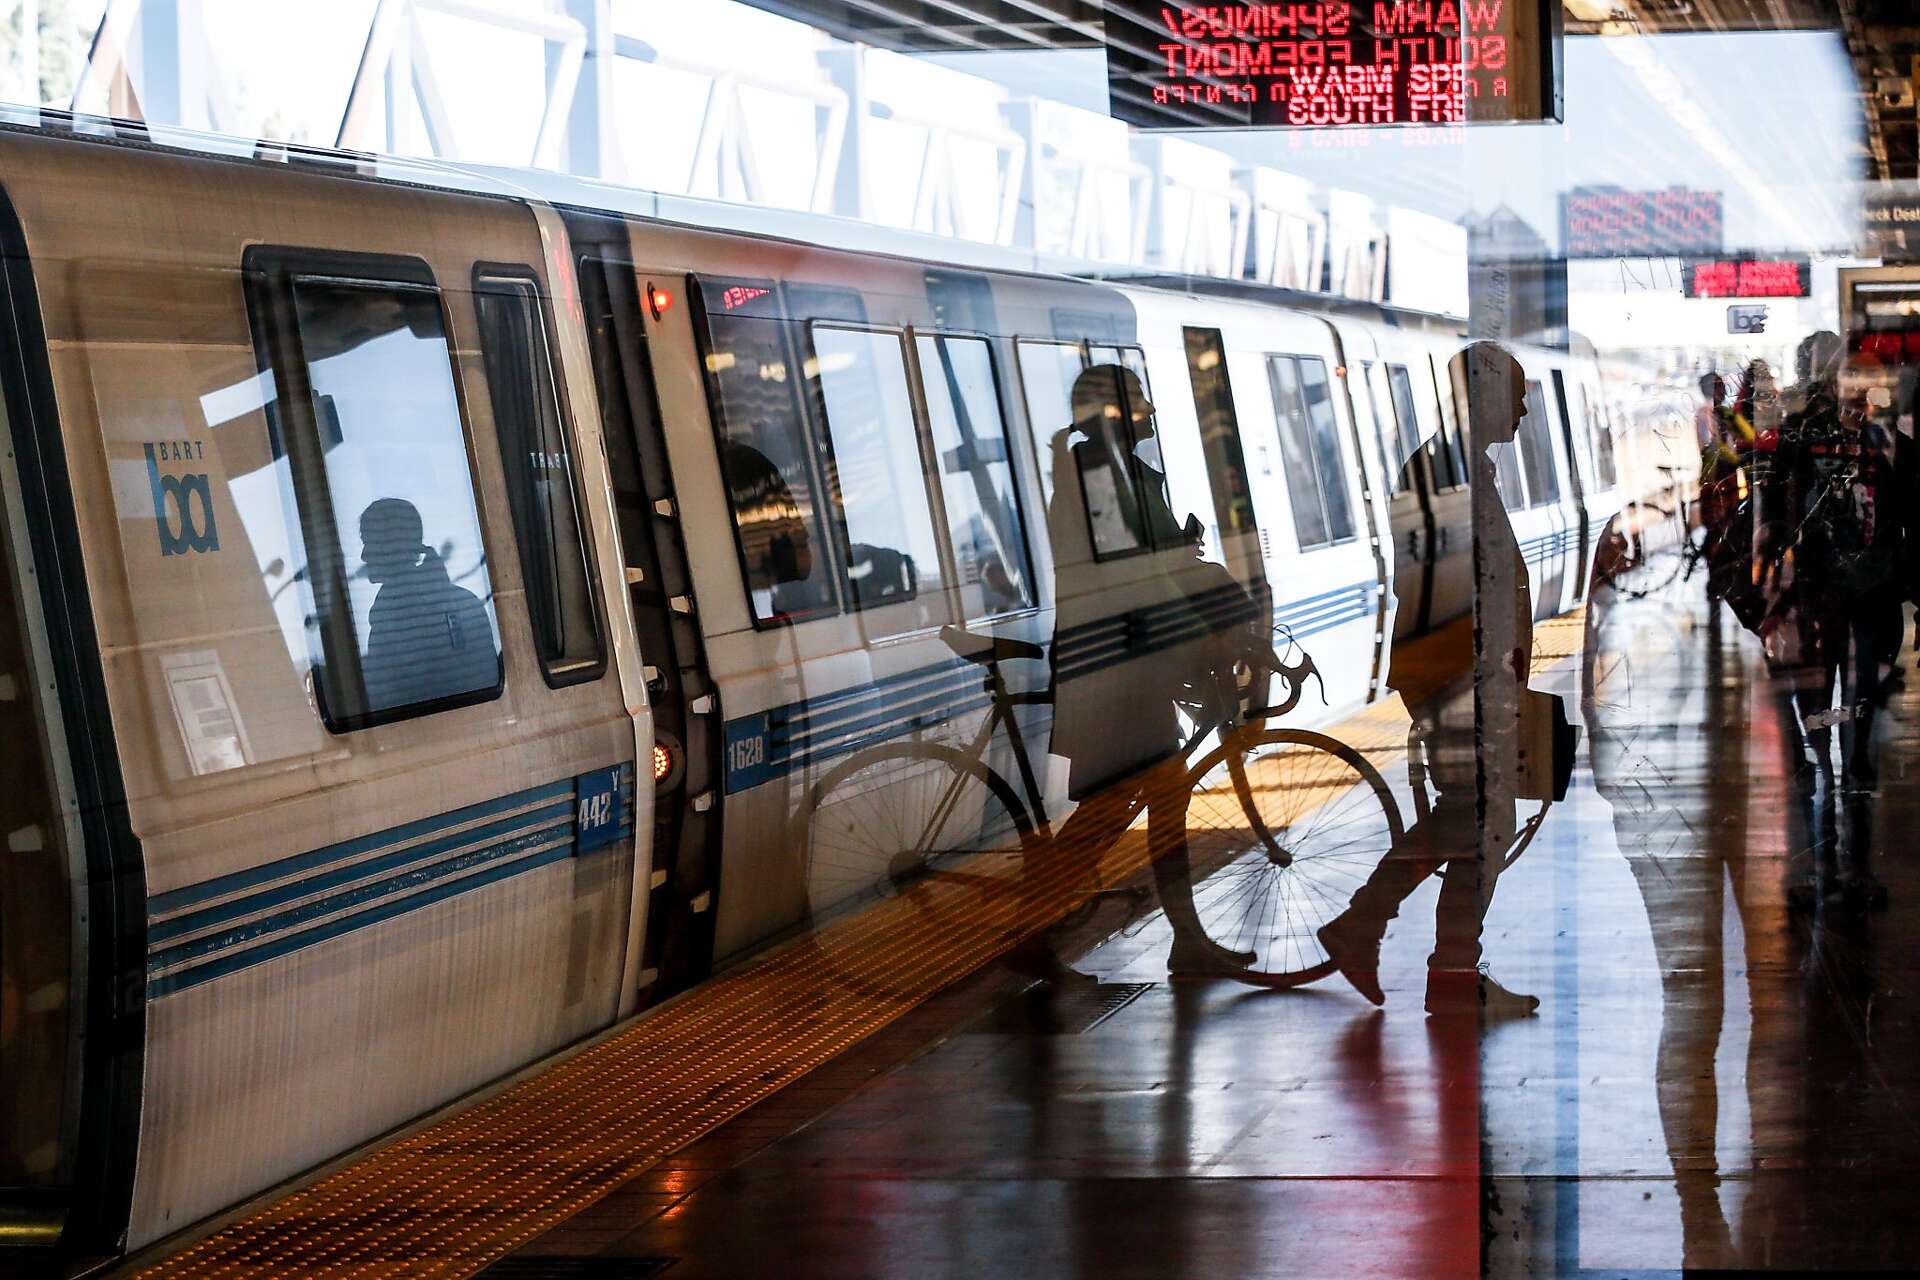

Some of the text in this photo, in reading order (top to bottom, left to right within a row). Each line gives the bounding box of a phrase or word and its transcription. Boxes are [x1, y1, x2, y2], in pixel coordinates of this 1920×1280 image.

[1289, 64, 1393, 94] WARM
[1289, 96, 1394, 124] SOUTH
[159, 440, 204, 462] BART
[728, 735, 764, 772] 1628
[611, 769, 619, 792] Y
[578, 791, 611, 832] 442
